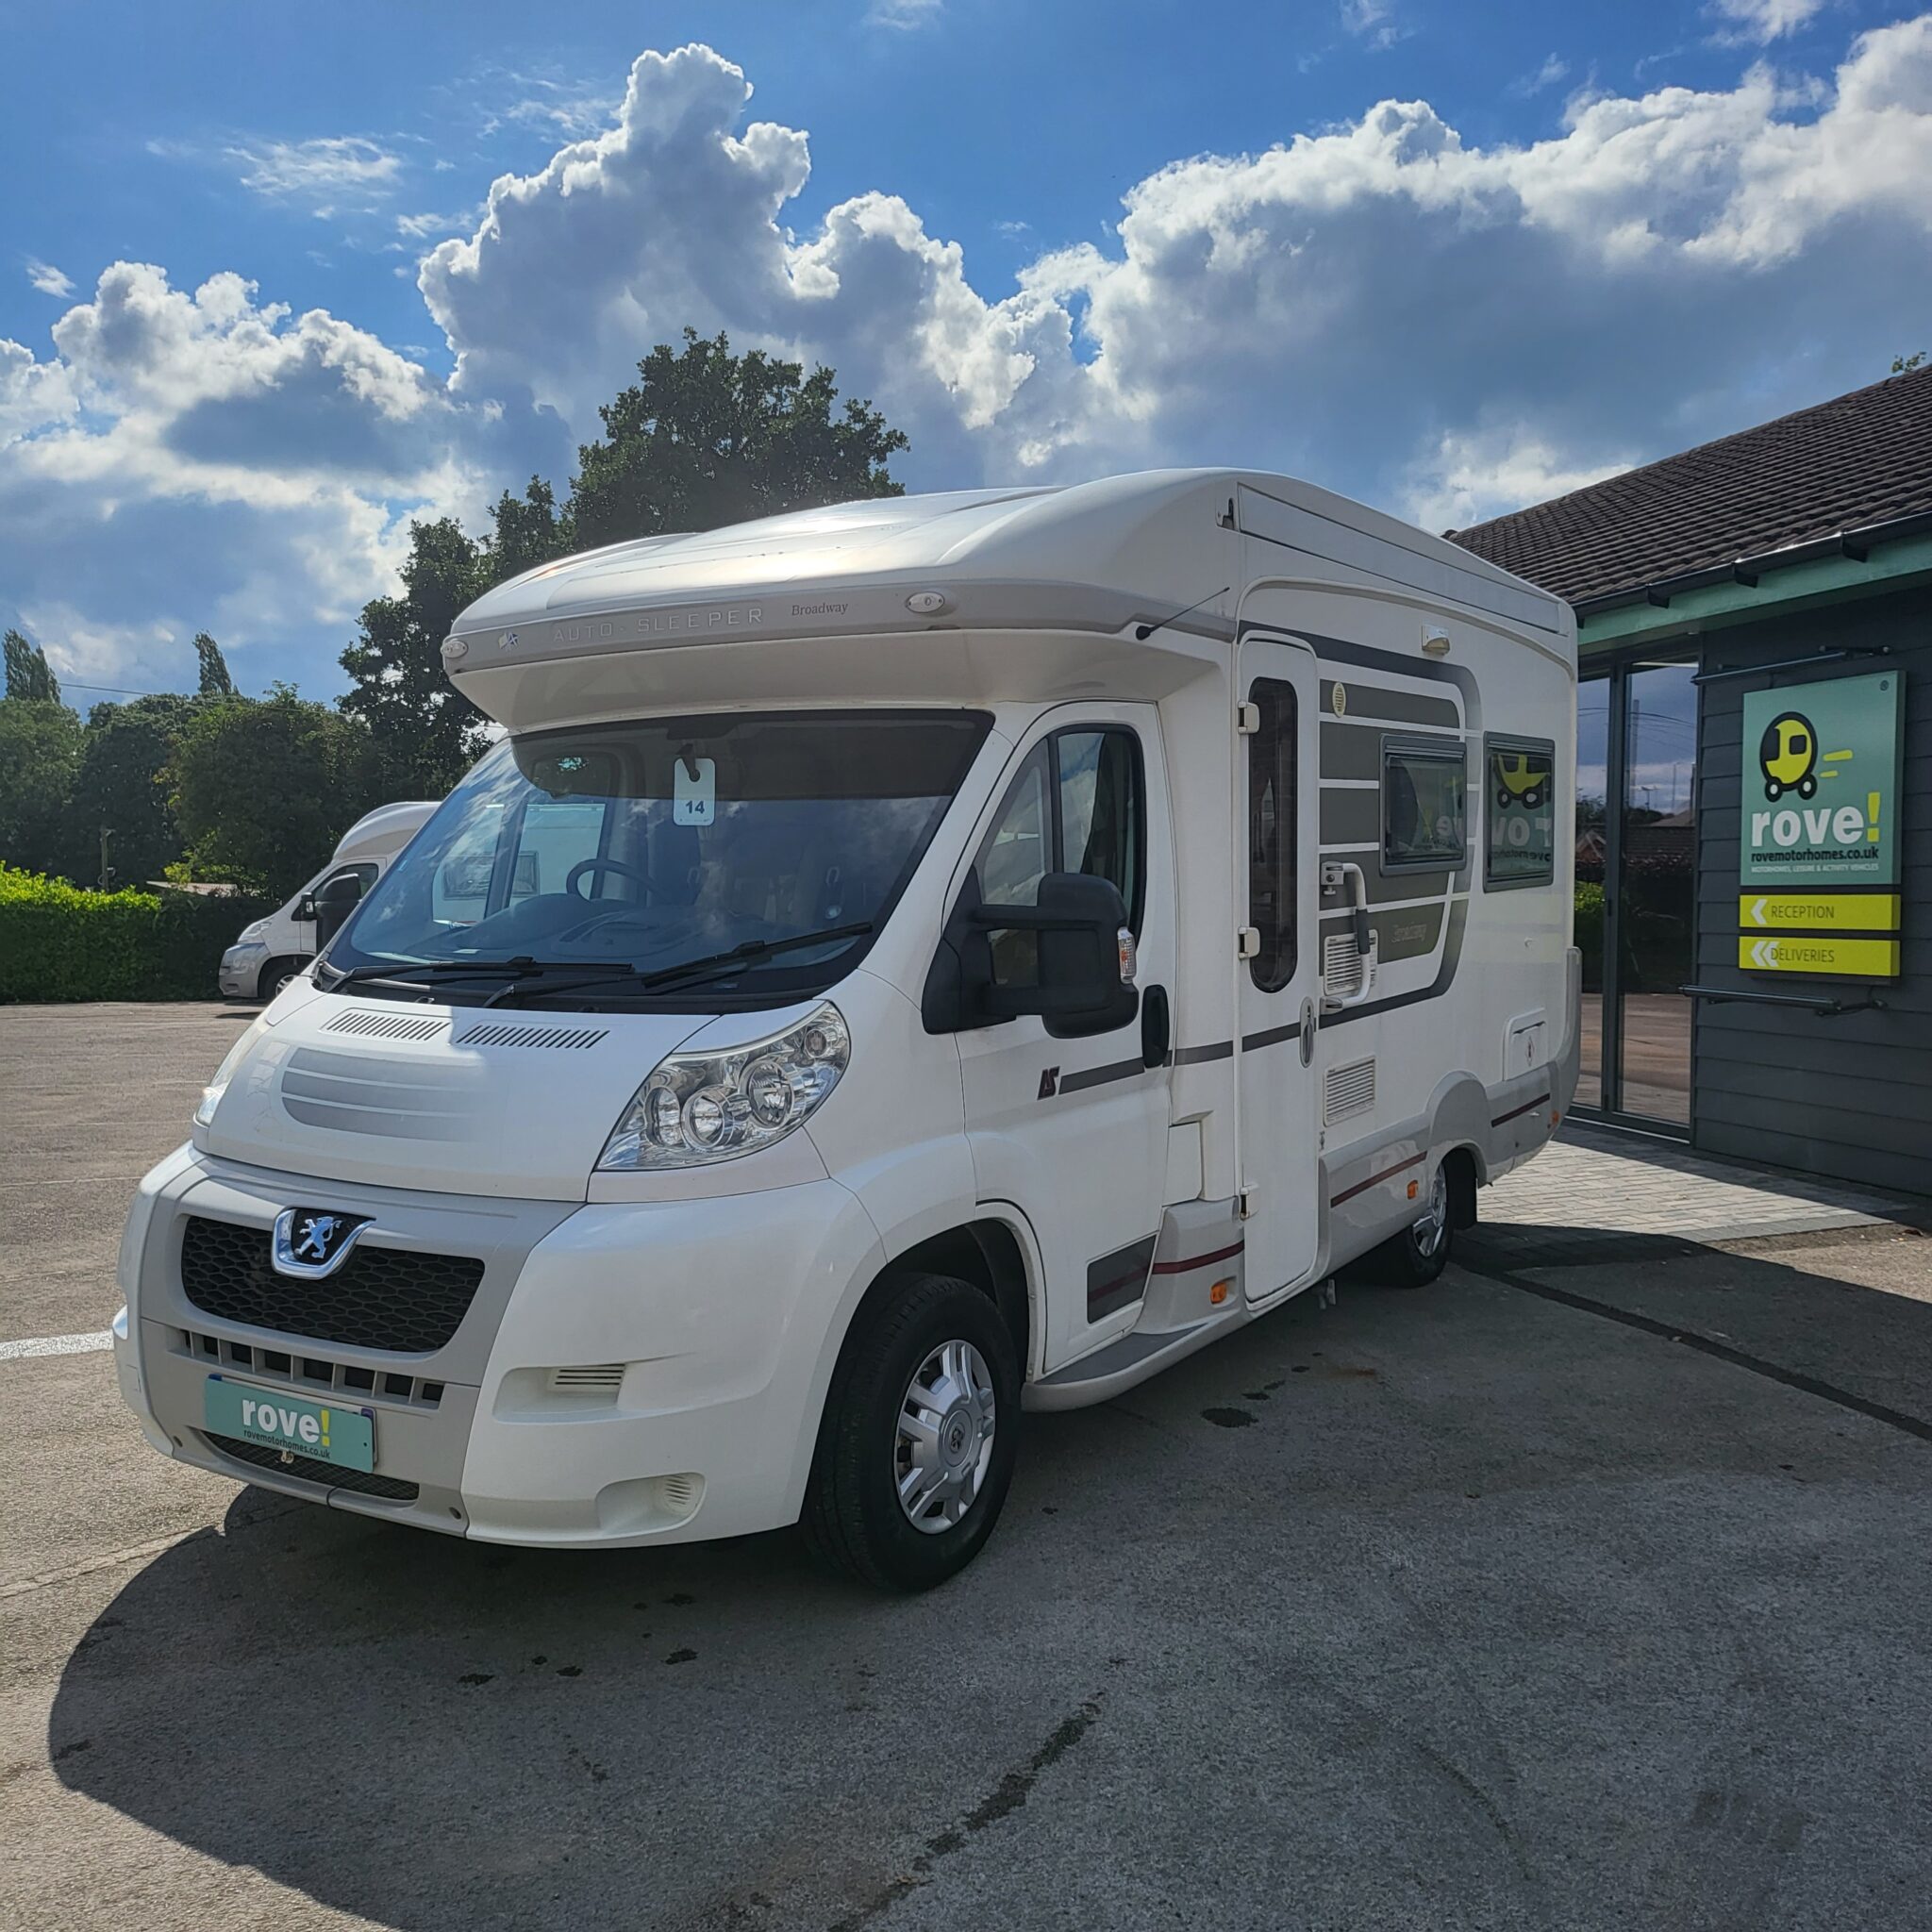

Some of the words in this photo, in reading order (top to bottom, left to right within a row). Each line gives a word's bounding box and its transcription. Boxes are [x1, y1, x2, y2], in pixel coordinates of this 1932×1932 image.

[791, 601, 849, 616] Broadway
[686, 800, 705, 814] 14
[1751, 791, 1881, 847] rove!
[1751, 846, 1880, 863] rovemotorhomes.co.uk
[1771, 905, 1835, 919] RECEPTION
[1771, 947, 1835, 963] DELIVERIES
[242, 1399, 330, 1447] rove!
[243, 1429, 330, 1459] rovemotorhomes.co.uk
